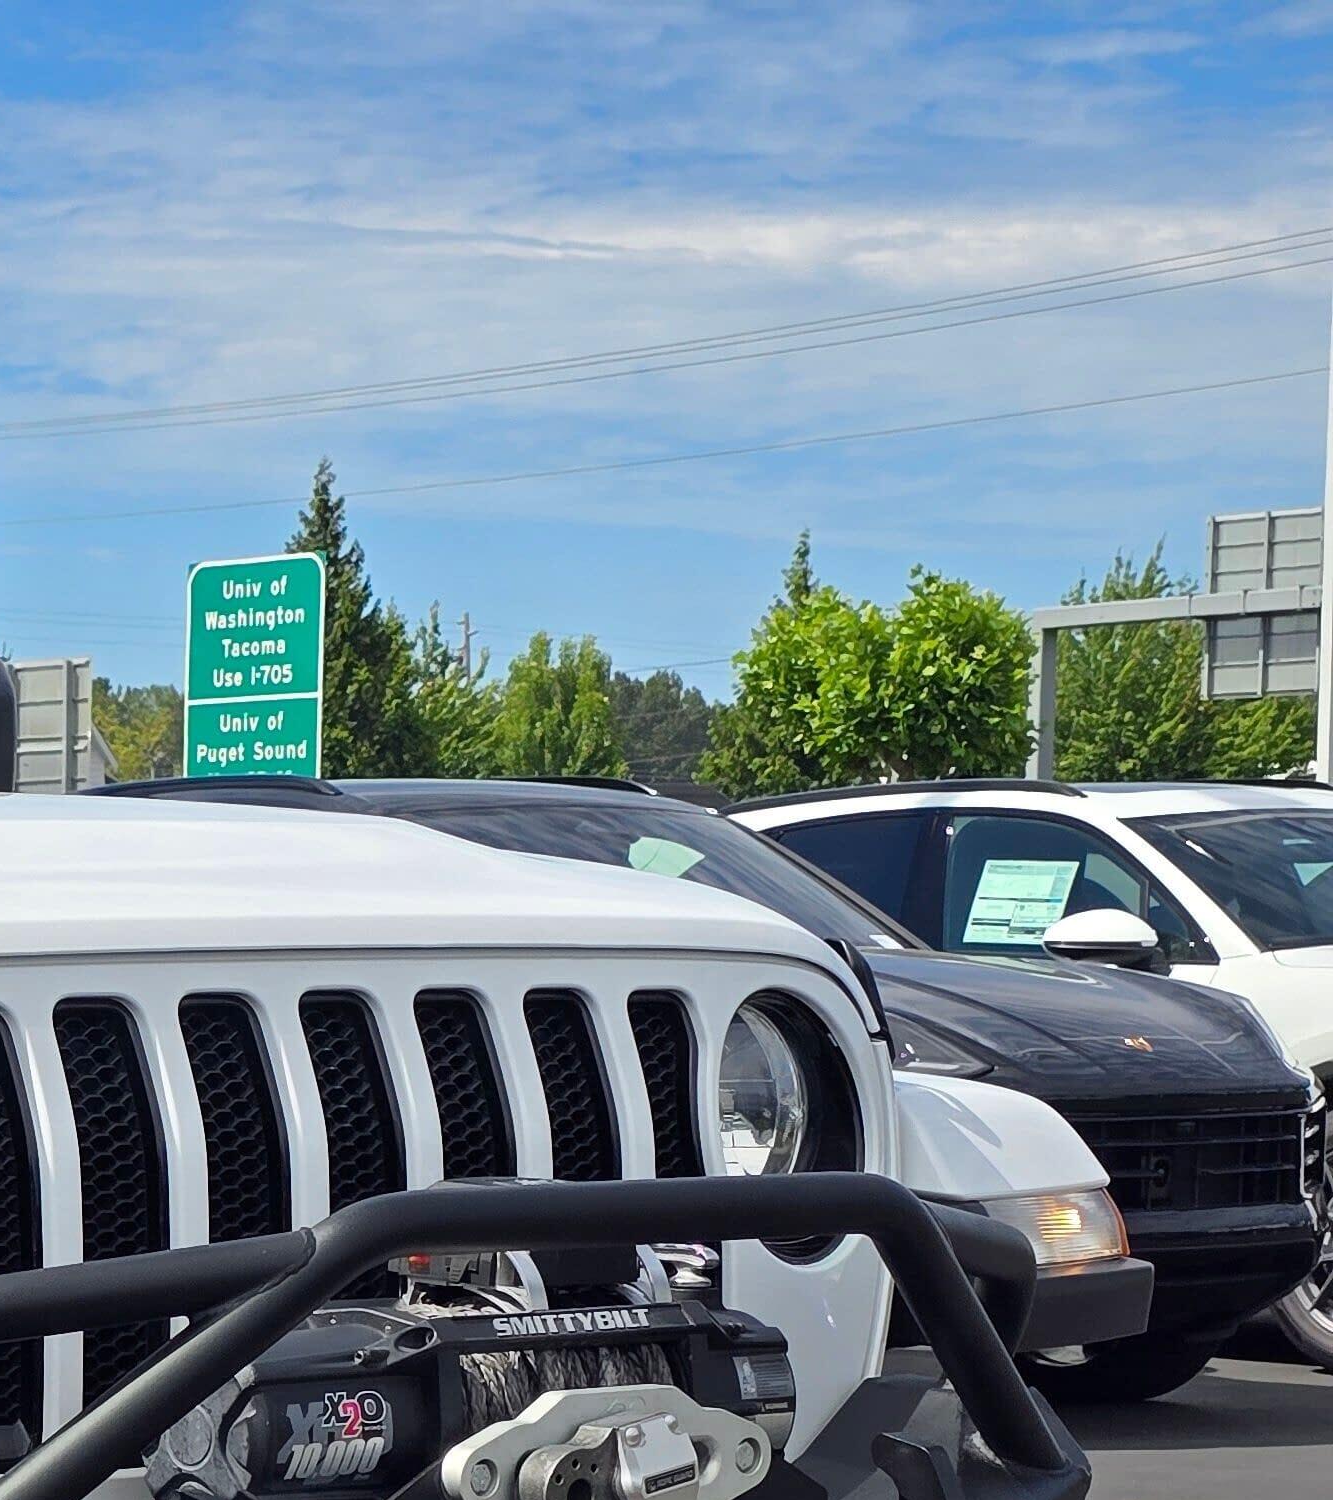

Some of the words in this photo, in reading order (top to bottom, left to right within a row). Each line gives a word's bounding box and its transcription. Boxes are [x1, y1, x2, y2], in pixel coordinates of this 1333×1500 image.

[222, 579, 261, 599] Univ
[270, 575, 287, 596] of
[205, 606, 304, 630] Washington
[221, 638, 286, 659] Tacoma
[212, 668, 243, 688] Use
[250, 664, 293, 685] I-705
[219, 713, 258, 732] Univ
[267, 710, 284, 730] of
[196, 743, 244, 767] Puget
[253, 740, 307, 760] Sound
[492, 1308, 651, 1337] SMITTYBILT
